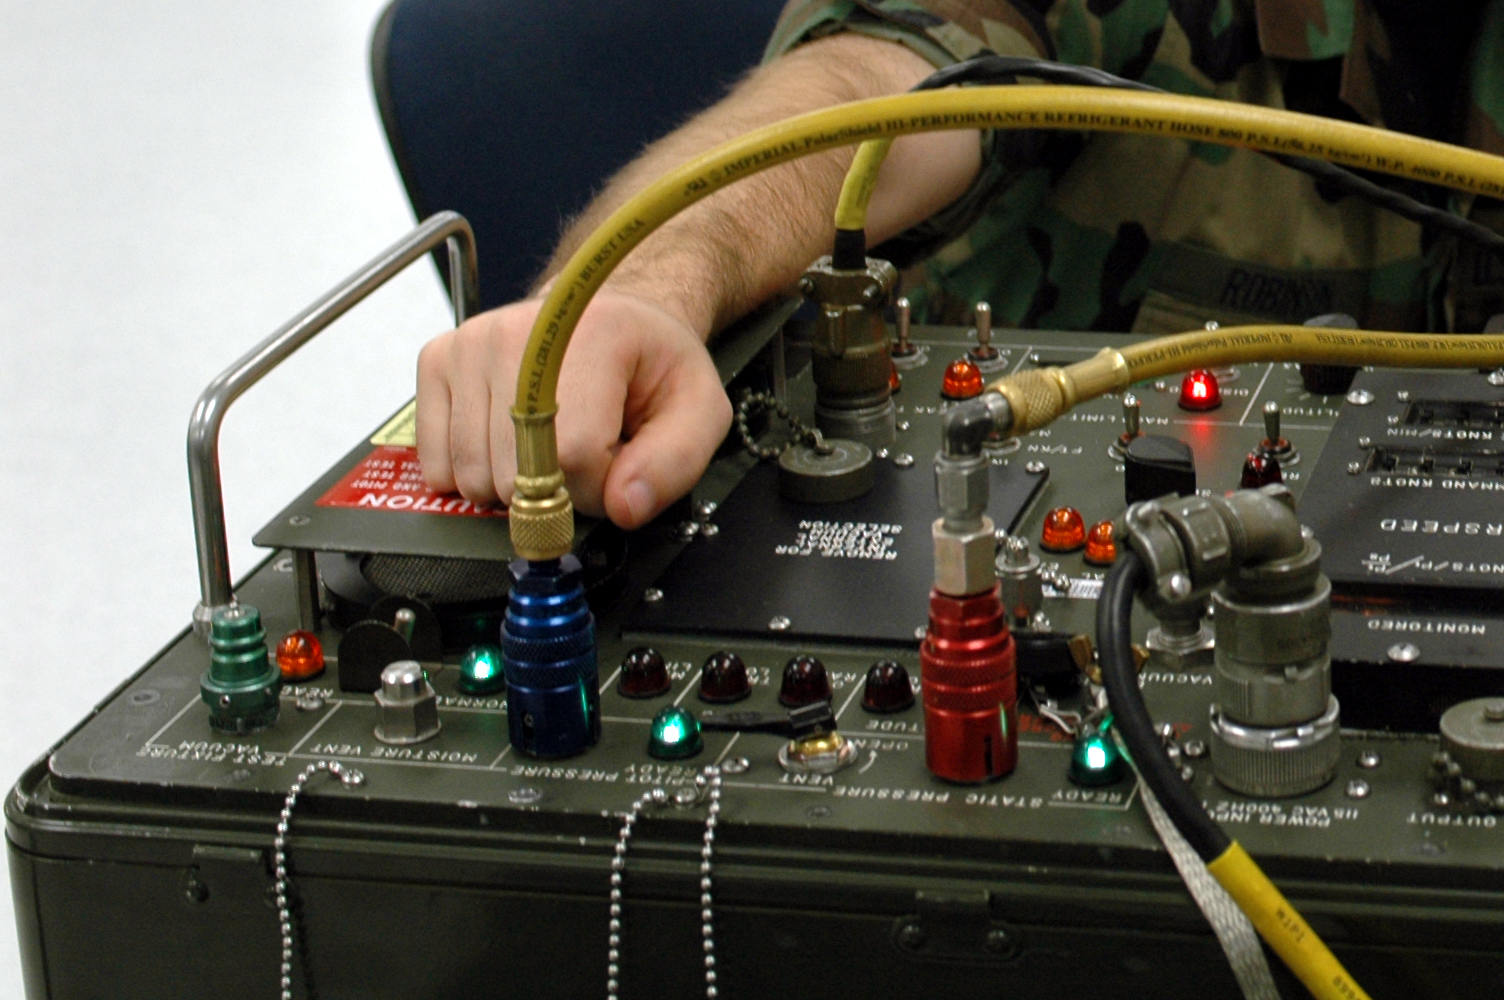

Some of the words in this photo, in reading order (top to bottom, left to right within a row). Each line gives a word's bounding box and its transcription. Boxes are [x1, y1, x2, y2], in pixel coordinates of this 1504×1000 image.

[721, 142, 799, 178] IMPERIAL
[884, 111, 1040, 131] HI-PERFORMANCE
[1045, 111, 1164, 132] REFRIGERANT
[1170, 120, 1214, 136] HOSE
[579, 238, 618, 282] BURST
[618, 217, 646, 241] USA
[1127, 347, 1180, 367] HI-PERFO
[1069, 413, 1116, 423] LIMIT
[1386, 427, 1493, 441] KNOTS/MIN
[1370, 476, 1434, 488] KNOTS
[357, 492, 490, 515] UTION
[774, 544, 812, 556] FOR
[1367, 619, 1486, 635] MONITORED
[280, 686, 334, 699] READ
[178, 740, 260, 756] VACUUM
[310, 742, 361, 756] VENT
[854, 738, 909, 753] OPEN
[136, 747, 227, 762] FIXTURE
[232, 753, 287, 768] TEST
[370, 746, 478, 763] MOISTURE
[510, 764, 619, 783] PRESSURE
[624, 763, 698, 777] READY
[625, 772, 687, 787] PITOT
[778, 773, 834, 786] VENT
[833, 786, 950, 804] PRESSURE
[966, 793, 1043, 809] STATIC
[1051, 789, 1122, 804] READY
[1291, 805, 1329, 818] VAC
[1333, 807, 1359, 820] 115
[1259, 813, 1331, 828] POWER
[1406, 811, 1497, 829] OUTPUT
